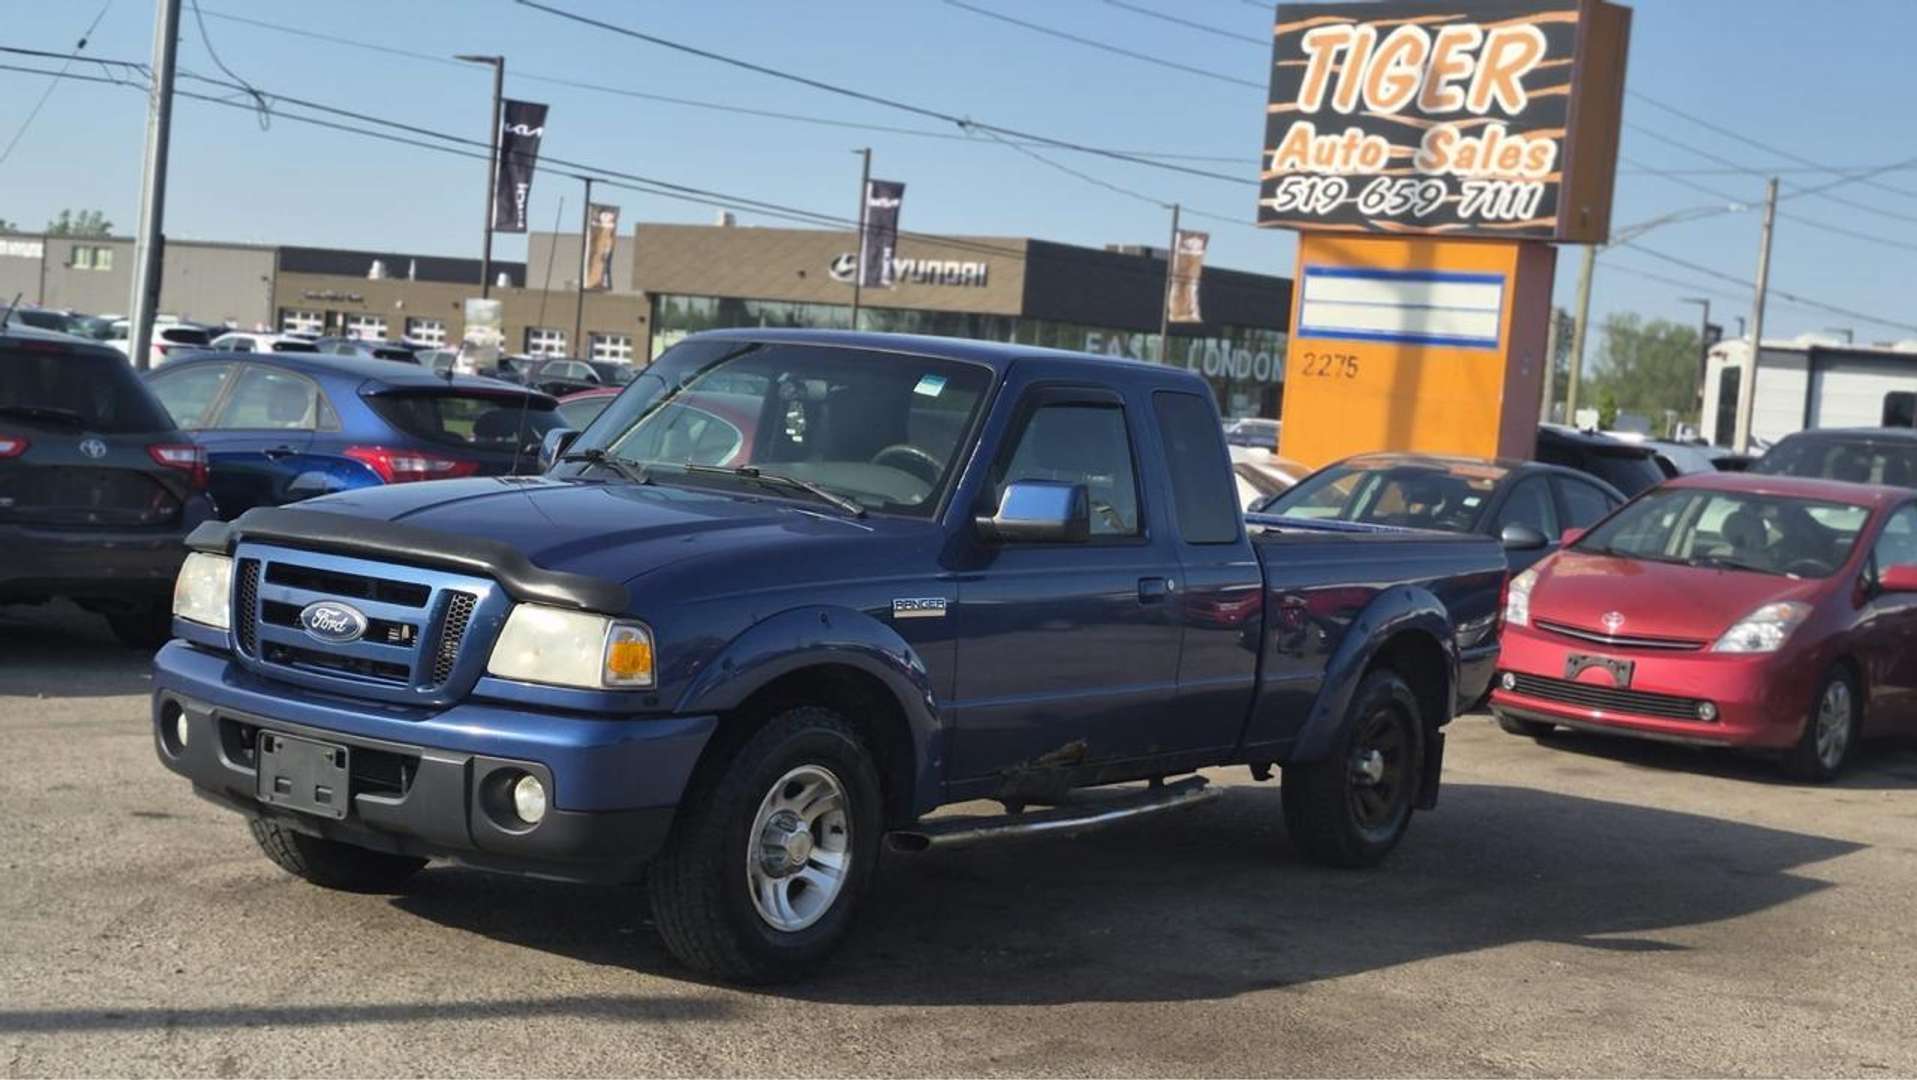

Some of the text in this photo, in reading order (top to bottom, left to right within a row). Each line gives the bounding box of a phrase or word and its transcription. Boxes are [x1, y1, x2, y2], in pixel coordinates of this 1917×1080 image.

[1297, 24, 1546, 115] TIGER
[1272, 121, 1557, 177] Auto Sales
[1273, 176, 1544, 220] 519 659 7111
[892, 256, 988, 288] YUNDAI
[1302, 352, 1359, 379] 2275
[311, 608, 349, 632] Ford
[893, 599, 946, 612] RANGER
